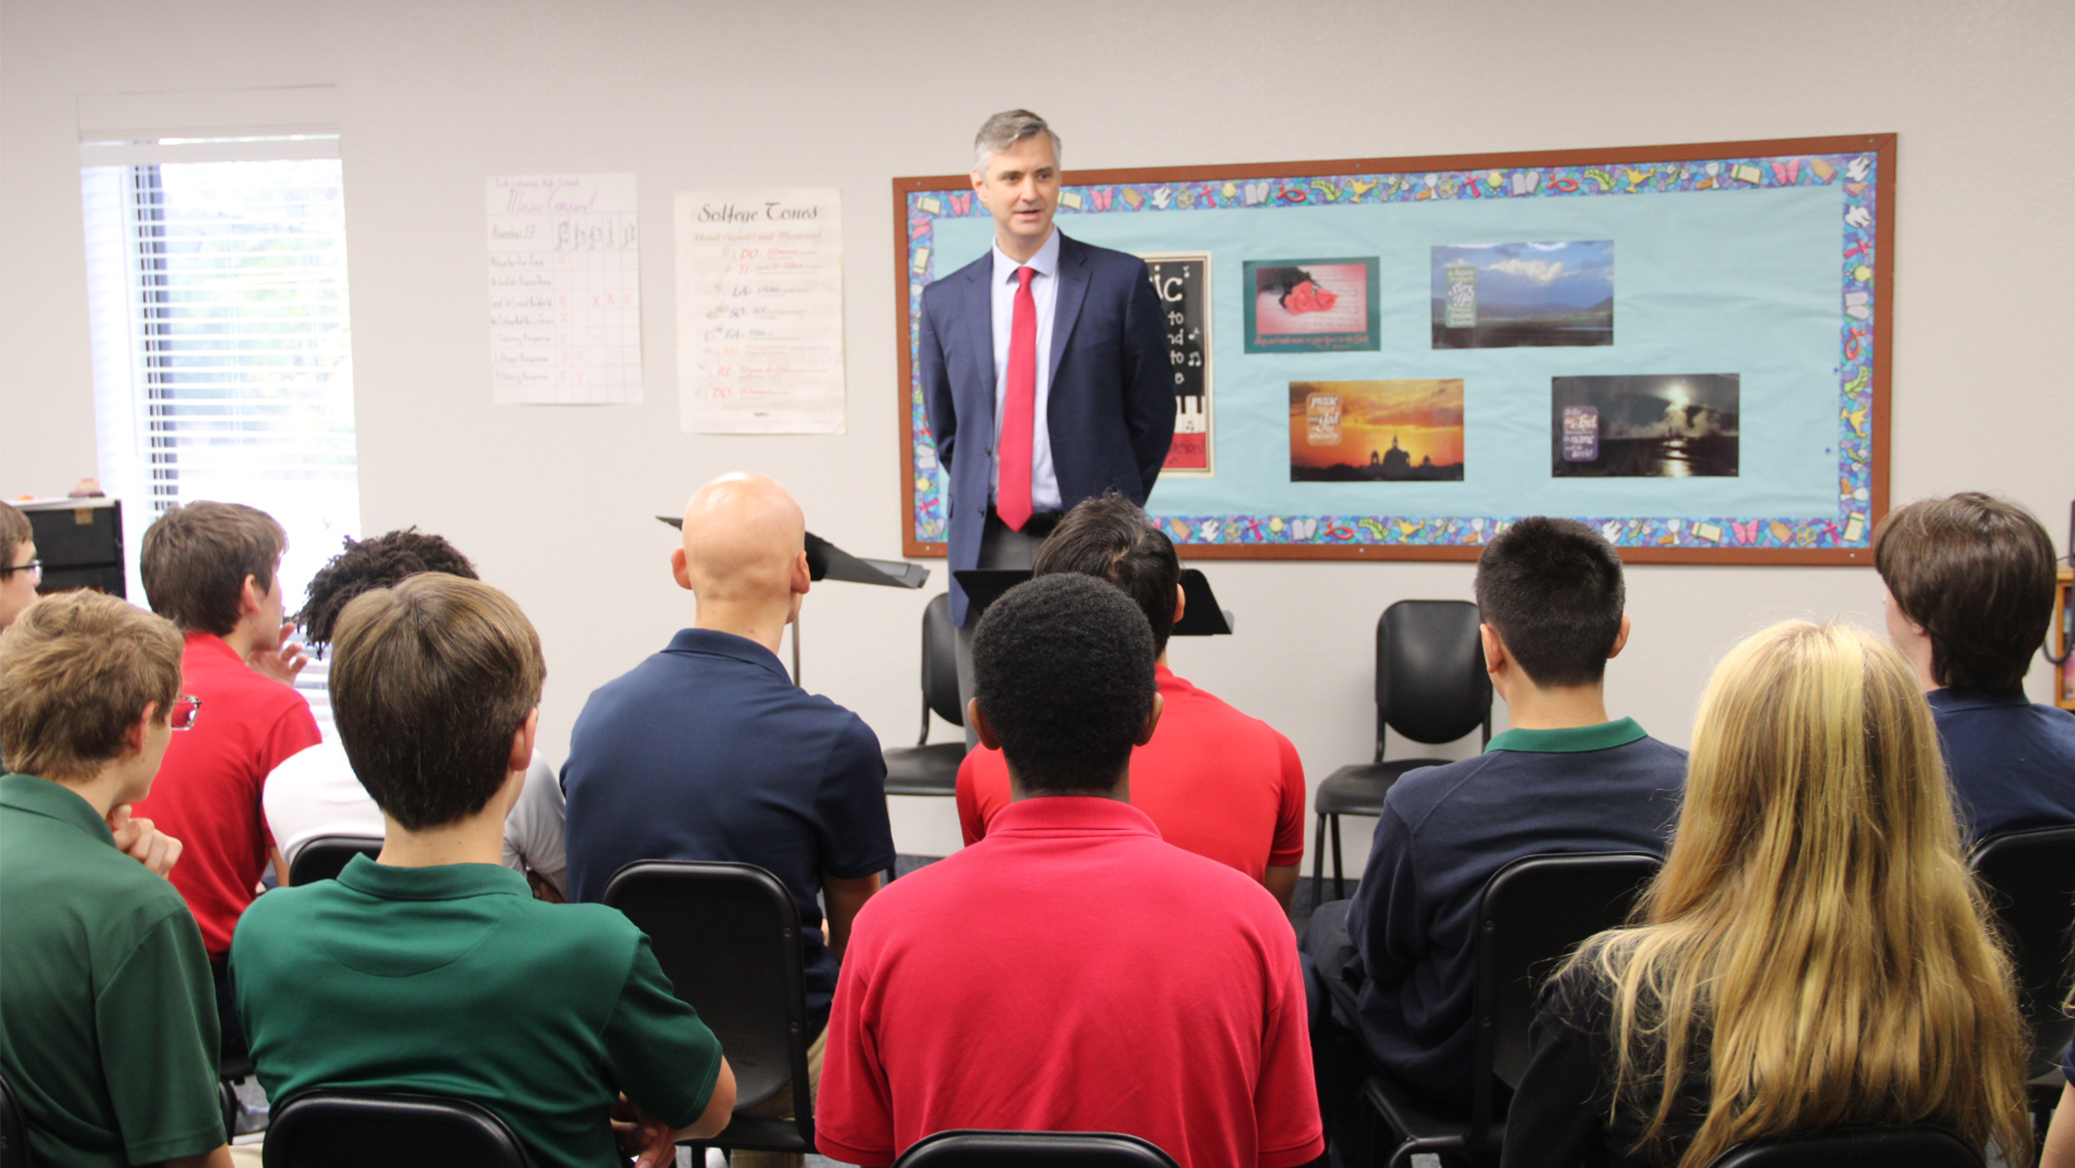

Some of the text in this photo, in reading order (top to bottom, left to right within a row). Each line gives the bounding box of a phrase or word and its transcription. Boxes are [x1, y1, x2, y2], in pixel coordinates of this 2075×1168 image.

[698, 201, 819, 225] Solfege Tones
[1149, 264, 1183, 302] ic
[1167, 310, 1184, 326] to
[1170, 350, 1185, 365] to
